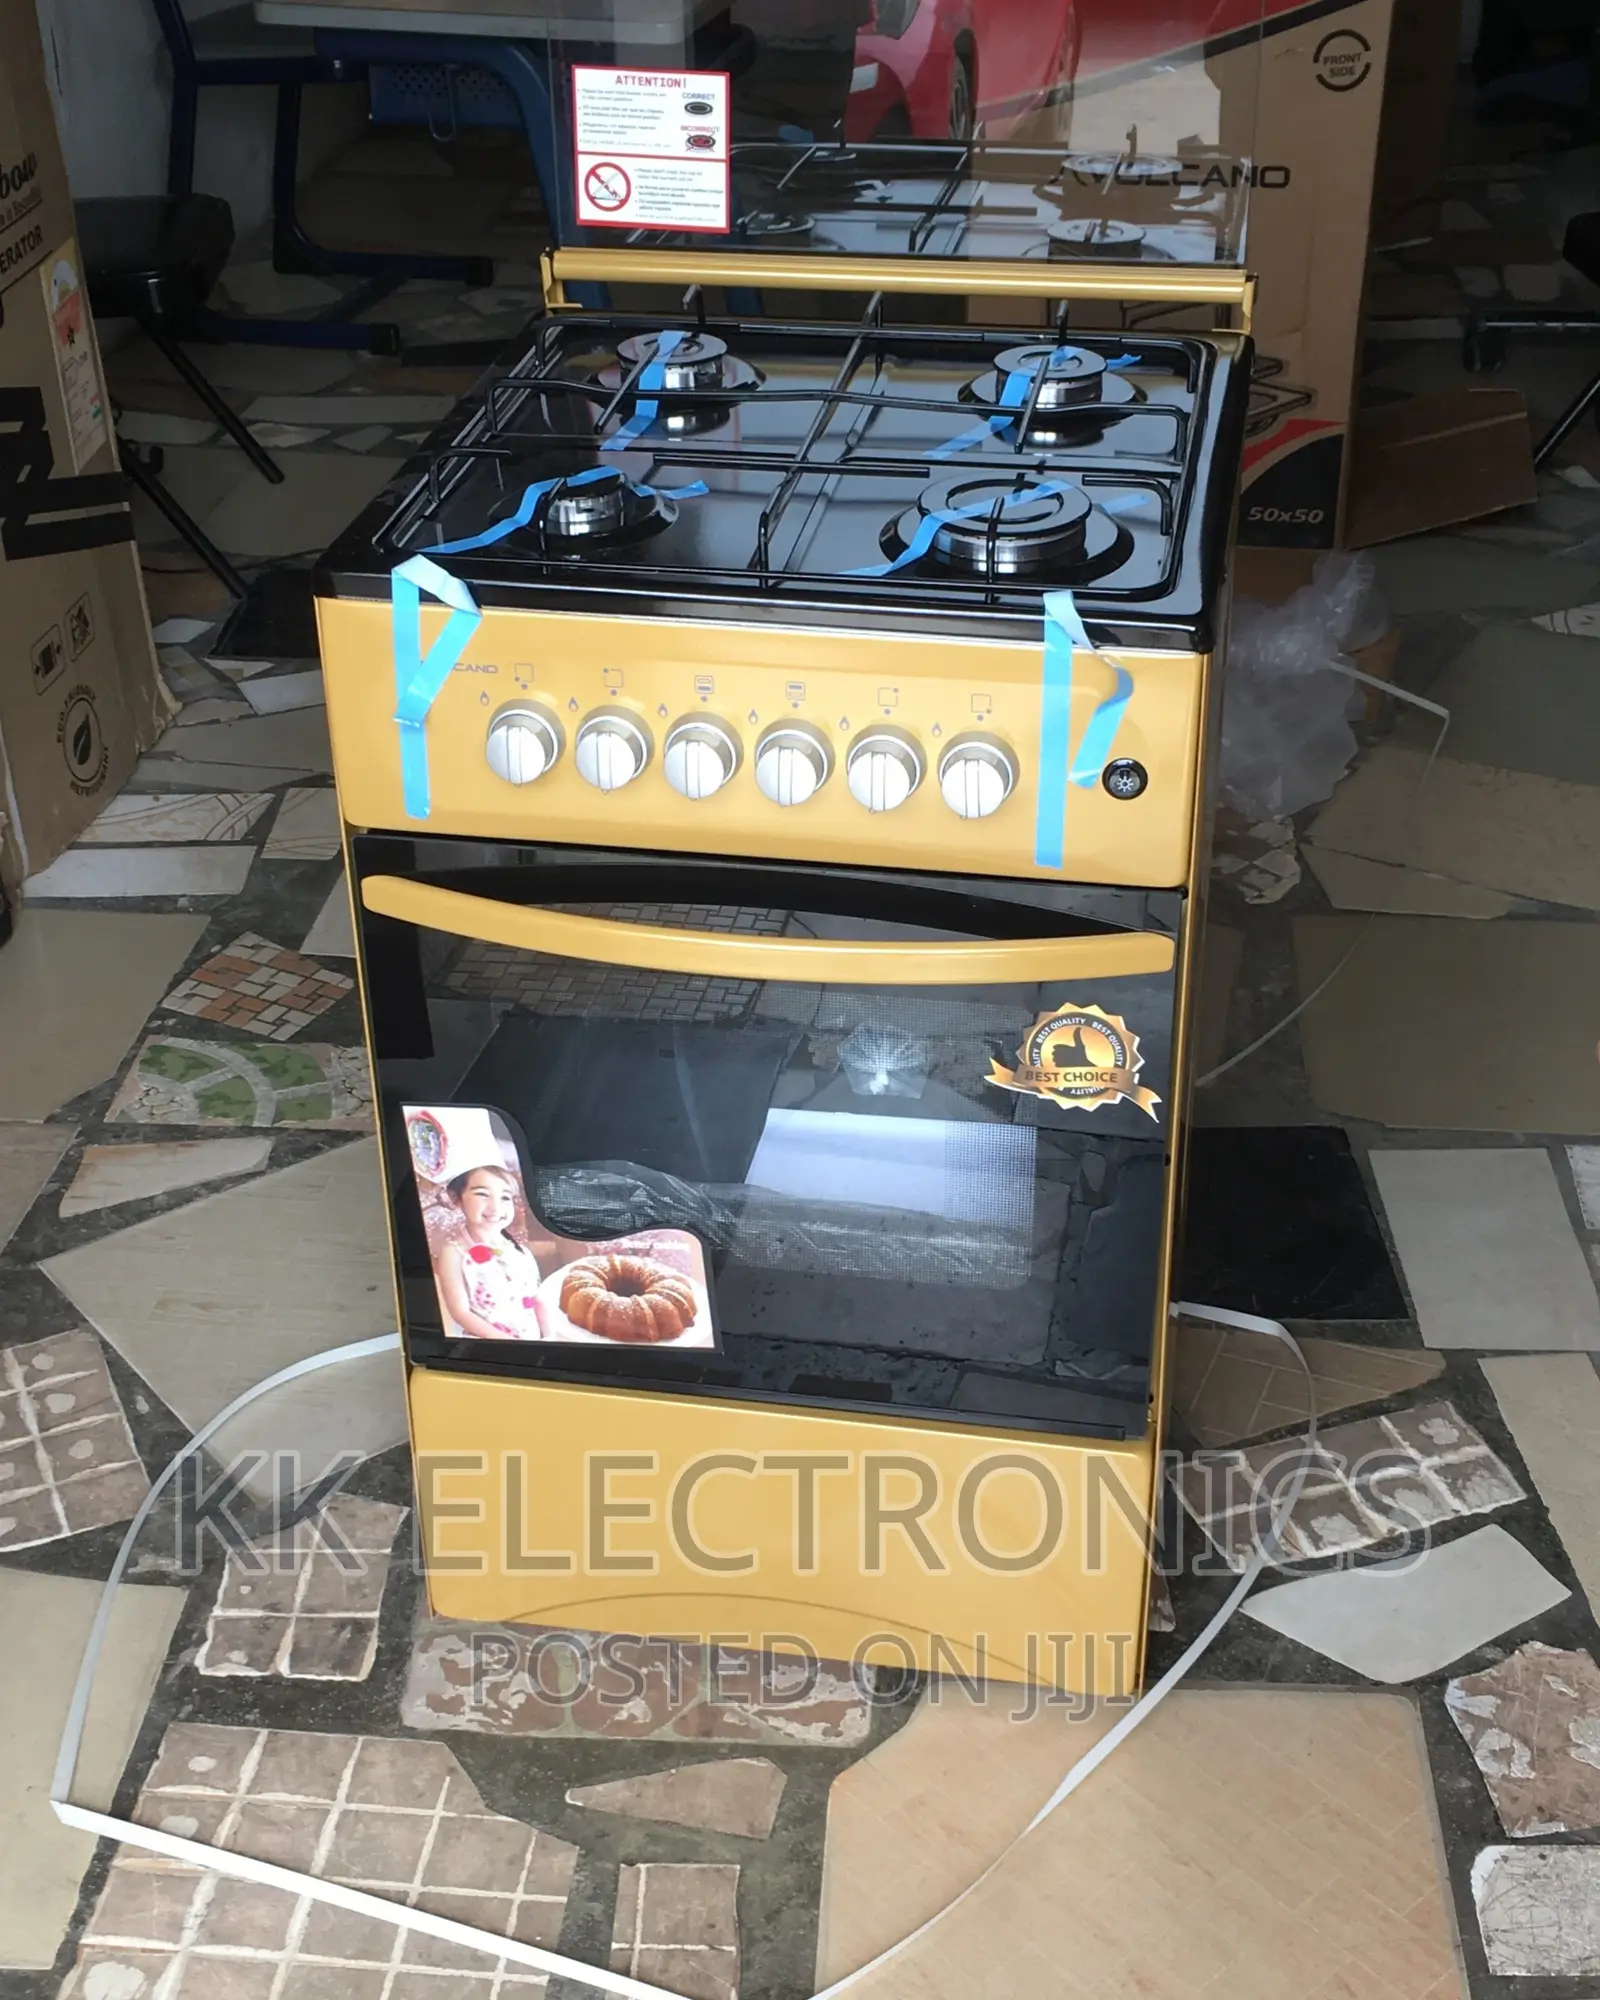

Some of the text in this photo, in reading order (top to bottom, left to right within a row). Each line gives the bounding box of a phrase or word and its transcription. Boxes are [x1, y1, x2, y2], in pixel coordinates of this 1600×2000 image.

[1323, 52, 1361, 65] FRONT
[1330, 65, 1355, 78] SIDE
[615, 75, 687, 88] ATTENTION!
[682, 92, 715, 100] CORRECT
[680, 125, 720, 133] INCORRECT
[1247, 506, 1324, 524] 50x50
[1036, 1017, 1087, 1043] BEST QUALITY
[1092, 1021, 1123, 1066] BEST QUALITY
[1025, 1070, 1118, 1083] BEST CHOICE
